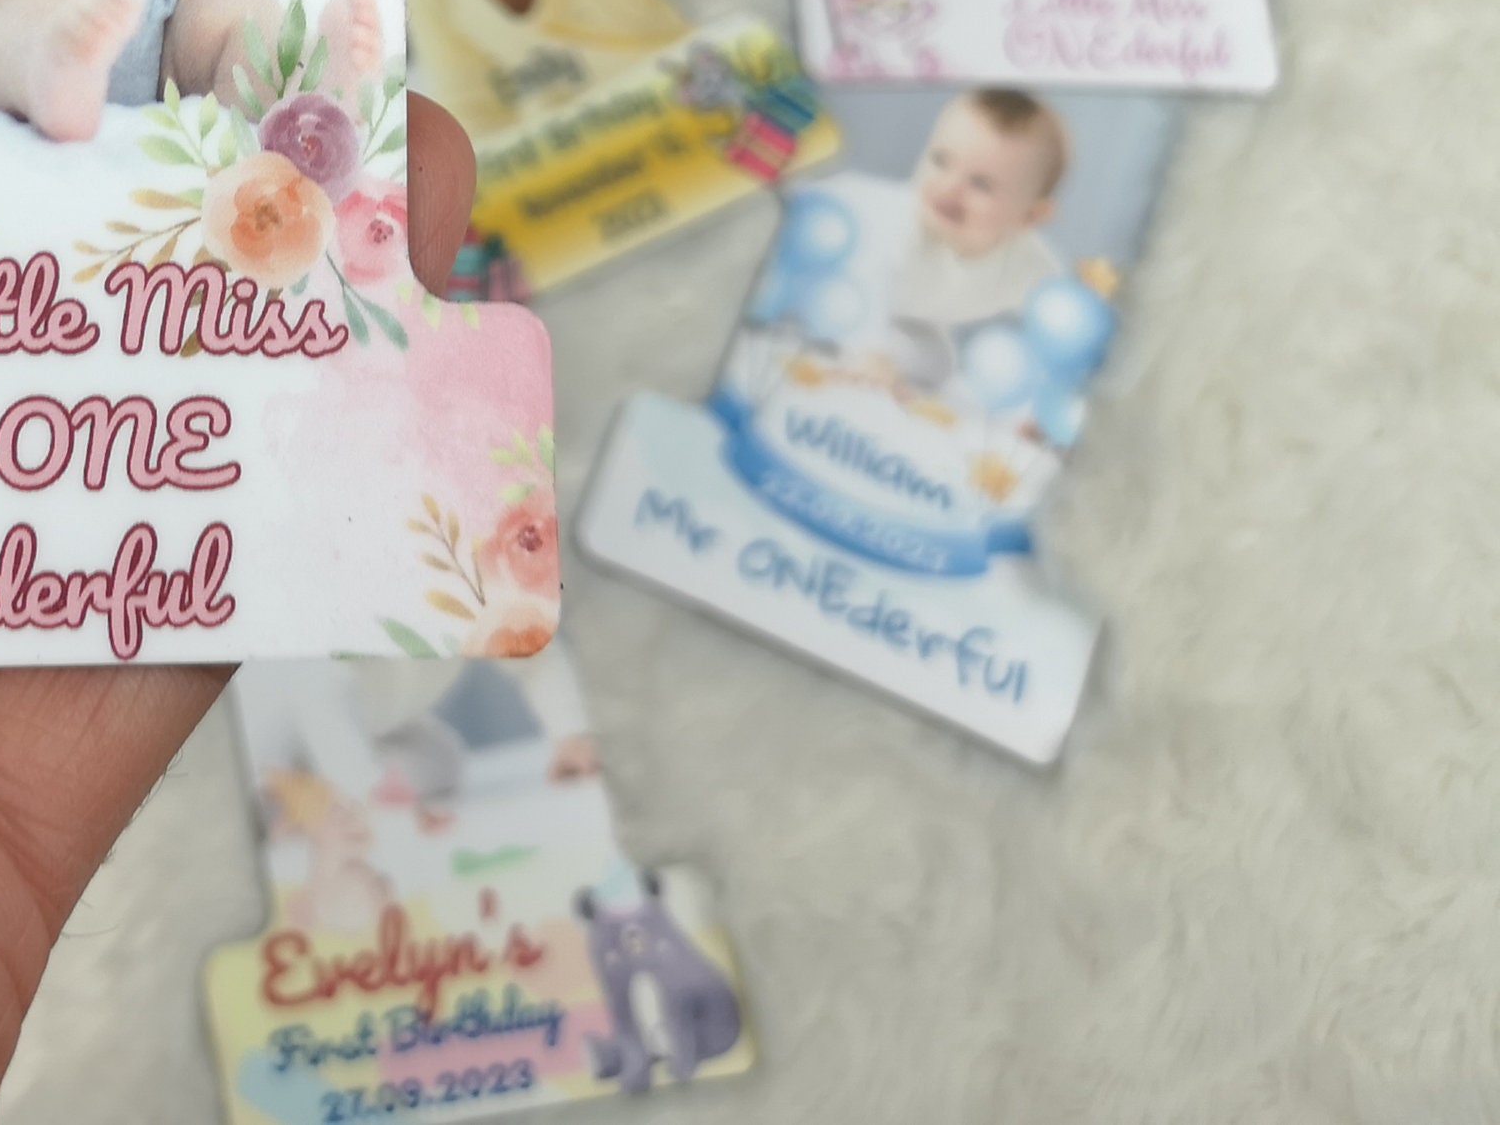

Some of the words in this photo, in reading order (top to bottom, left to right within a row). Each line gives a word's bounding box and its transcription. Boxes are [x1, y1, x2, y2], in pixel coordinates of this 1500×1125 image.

[105, 261, 349, 359] Miss
[782, 407, 955, 511] William
[634, 487, 720, 553] Mr
[736, 537, 1030, 705] ONEderful
[260, 886, 544, 1024] Evelyn's
[269, 1013, 377, 1073] First
[382, 982, 566, 1047] Birthday
